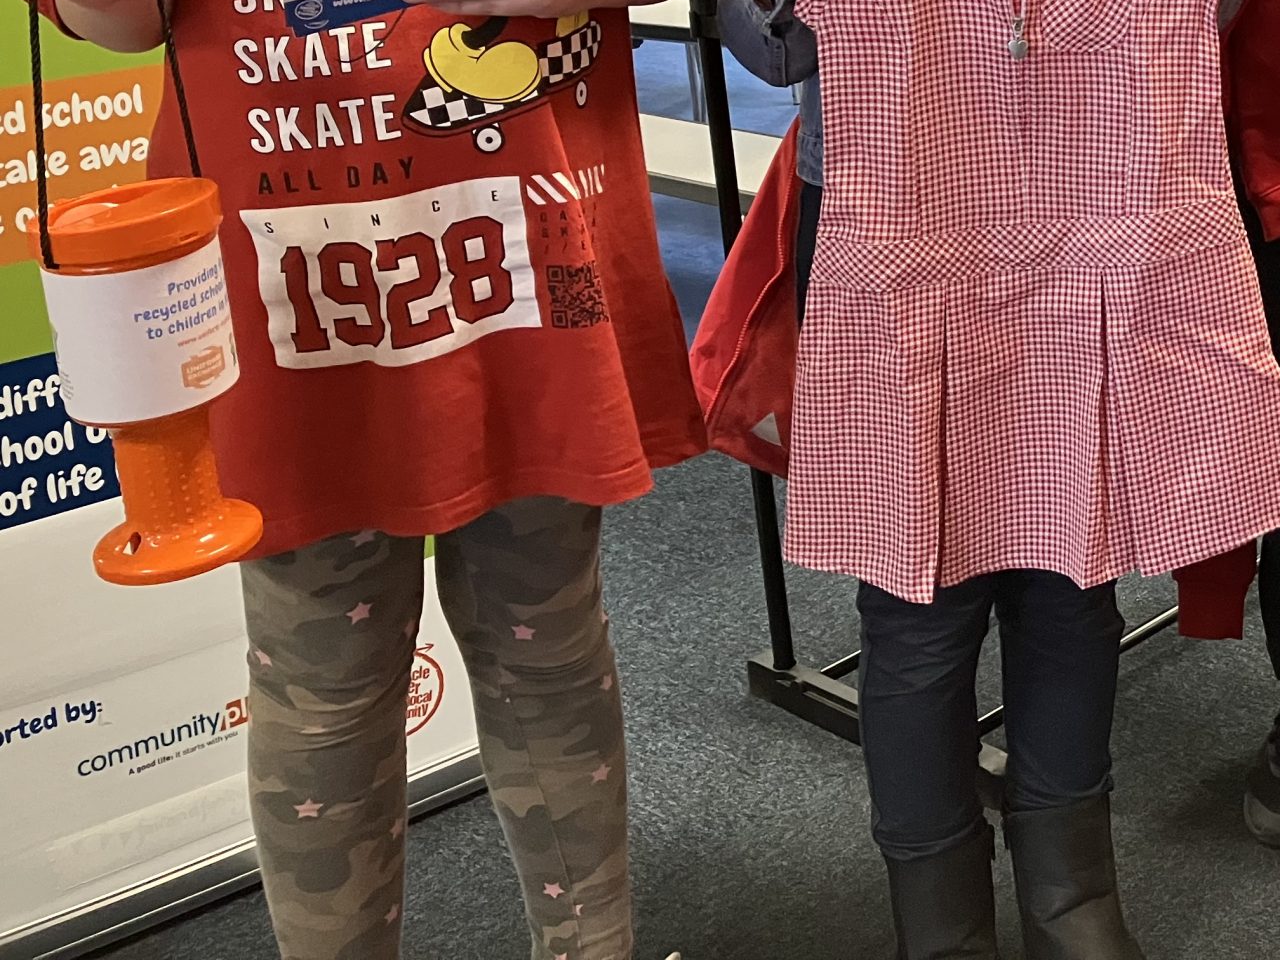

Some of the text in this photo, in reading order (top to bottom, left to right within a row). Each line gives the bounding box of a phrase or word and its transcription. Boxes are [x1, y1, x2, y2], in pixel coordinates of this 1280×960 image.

[233, 21, 392, 84] SKATE
[247, 94, 401, 153] SKATE
[79, 137, 149, 171] awa
[258, 157, 415, 195] ALL DAY
[264, 189, 499, 234] SINCE
[168, 263, 218, 296] Providing
[280, 216, 514, 353] 1928
[134, 293, 197, 324] recycled
[146, 327, 163, 340] to
[168, 305, 217, 335] children
[0, 374, 60, 419] diff
[0, 421, 74, 467] hool
[0, 464, 105, 516] of life
[65, 700, 102, 724] by:
[136, 759, 156, 774] good
[182, 743, 205, 756] starts
[206, 736, 223, 746] with
[224, 731, 238, 742] you
